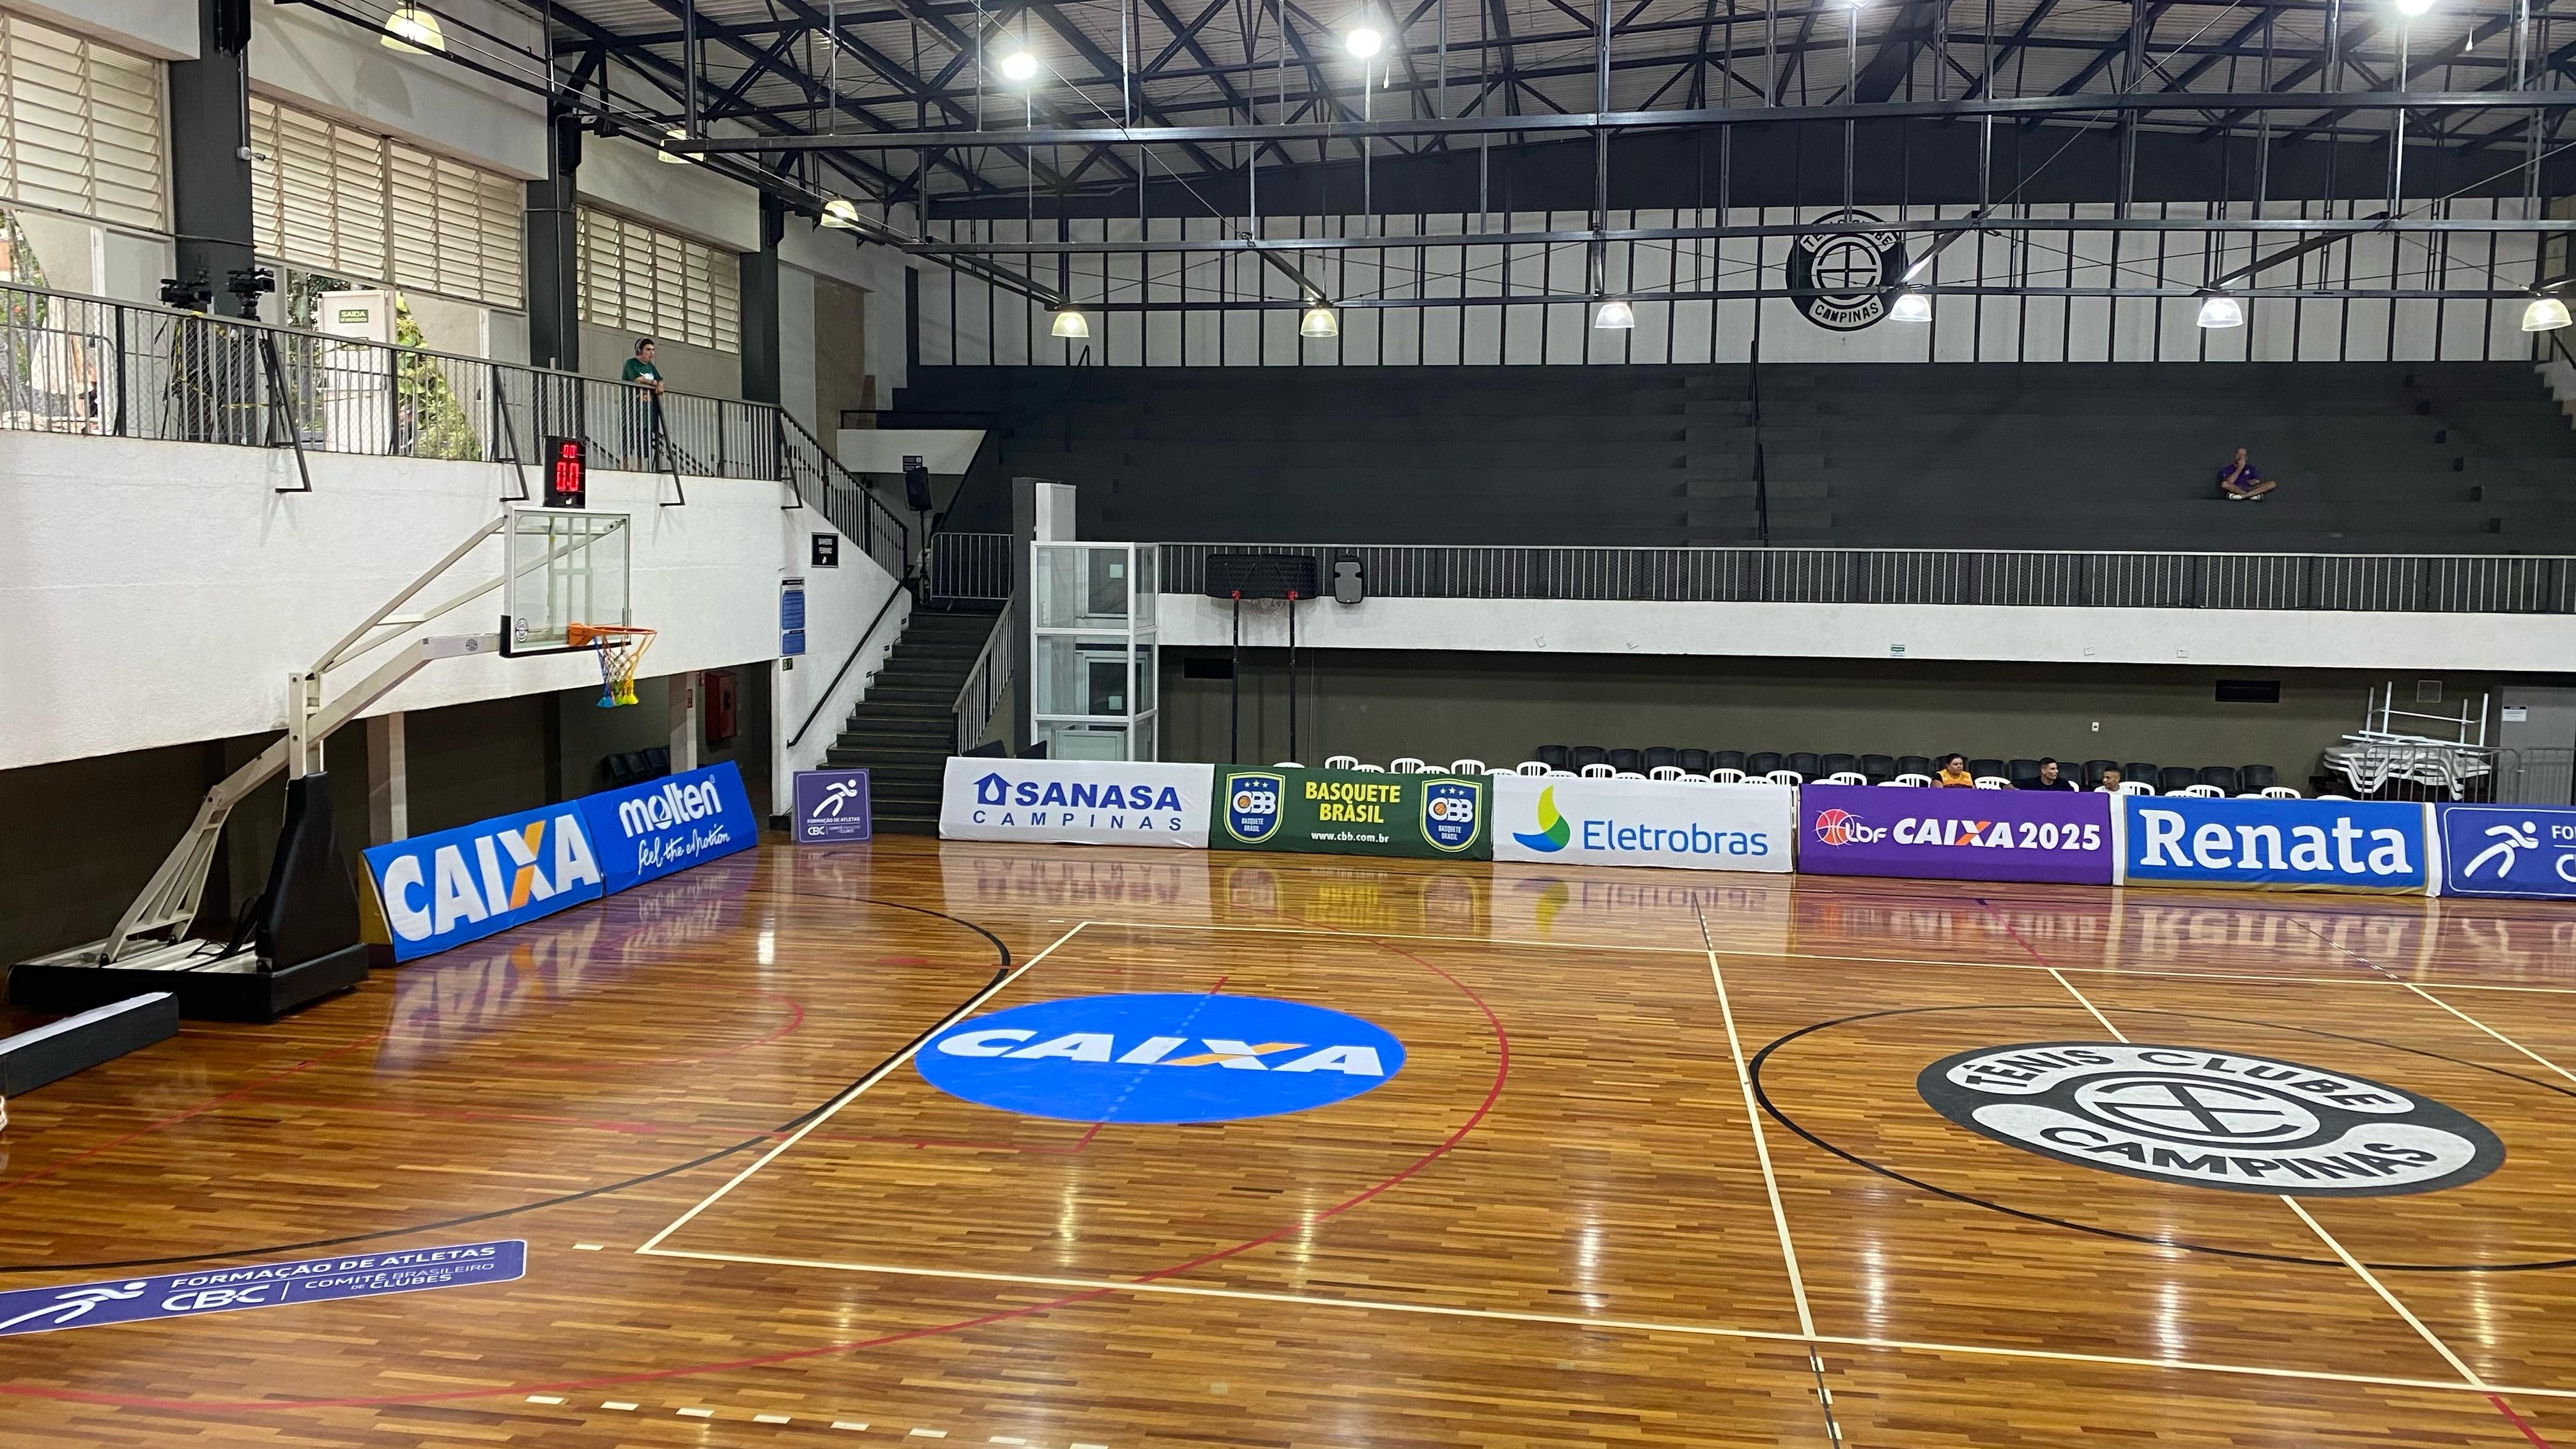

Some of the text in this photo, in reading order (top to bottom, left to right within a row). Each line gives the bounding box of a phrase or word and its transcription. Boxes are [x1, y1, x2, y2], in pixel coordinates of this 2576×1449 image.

[1815, 302, 1879, 323] CAMPINAS
[1015, 781, 1183, 812] SANASA
[1233, 790, 1276, 814] CBB
[1305, 781, 1401, 804] BASQUETE
[618, 781, 723, 838] molten
[972, 811, 1183, 832] CAMPINAS
[1319, 803, 1384, 824] BRASIL
[1428, 797, 1473, 823] CBB
[808, 826, 825, 836] CBC
[1311, 831, 1390, 843] www.cbb.com.br
[1438, 825, 1461, 833] BASQUETE
[1583, 820, 1769, 856] Eletrobras
[1892, 818, 2014, 848] CAIXA
[2018, 822, 2101, 852] 2025
[2139, 809, 2413, 875] Renata
[638, 836, 663, 875] feel
[663, 836, 684, 862] the
[384, 814, 601, 941] CAIXA
[937, 1029, 1385, 1077] CAIXA
[1961, 1050, 2396, 1108] TÊNIS CLUBE
[2040, 1126, 2438, 1180] CAMPINAS
[171, 1246, 496, 1288] FORMAÇÃO DE ATLETAS
[369, 1274, 452, 1289] CLUBES
[161, 1262, 494, 1312] CBC COMITÊ BRASILEIRO
